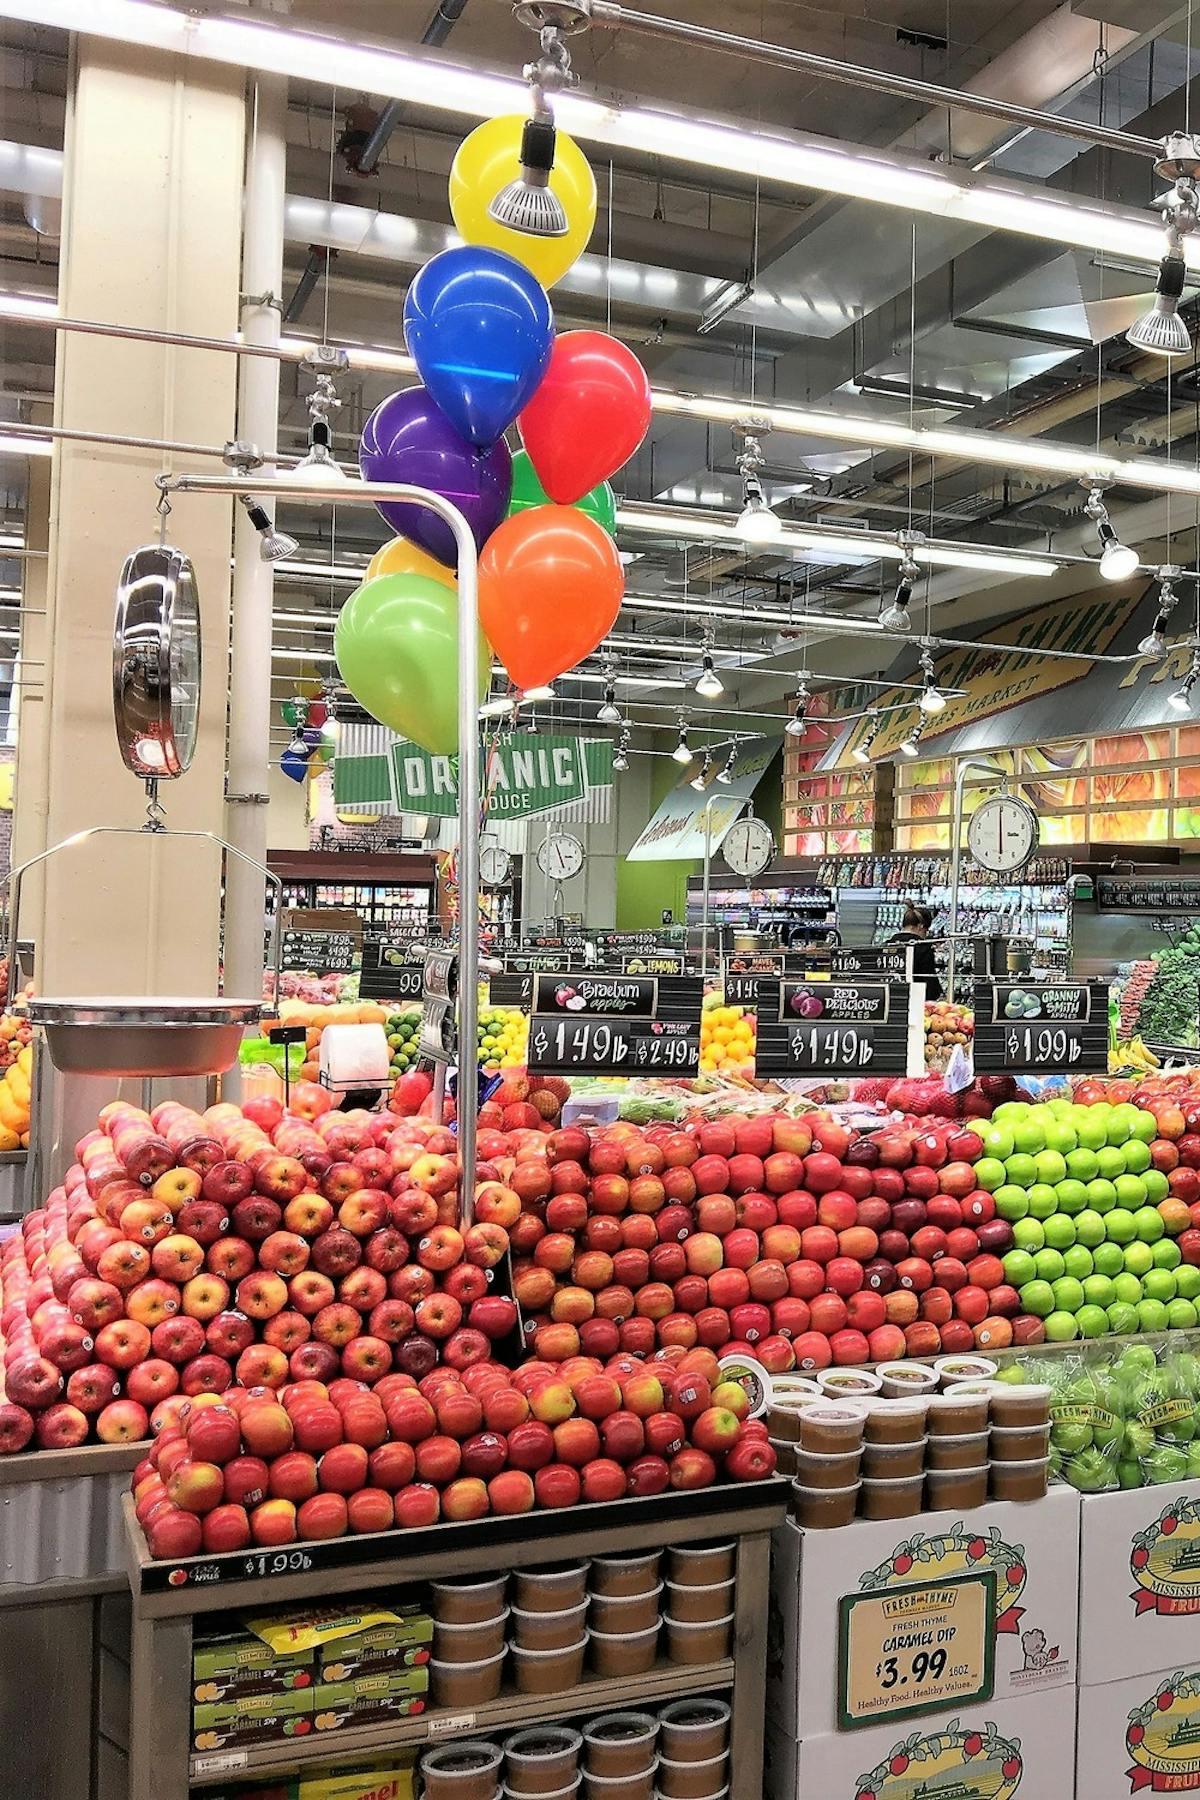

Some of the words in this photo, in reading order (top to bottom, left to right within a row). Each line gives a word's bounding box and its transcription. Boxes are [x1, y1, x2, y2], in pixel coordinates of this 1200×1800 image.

[961, 673, 1040, 717] MARKET
[403, 748, 575, 798] ORANIC
[647, 960, 679, 974] LEMONS
[578, 980, 640, 998] Braeburn
[832, 987, 859, 999] RED
[1042, 989, 1080, 1003] GRANNY
[825, 998, 880, 1012] DELICIOUS
[831, 1011, 871, 1019] APPLES
[886, 1595, 918, 1614] FRESH
[924, 1591, 955, 1604] THYME
[892, 1620, 919, 1632] FRESH
[921, 1614, 948, 1627] THYME
[883, 1631, 933, 1652] CARAMEL
[937, 1626, 956, 1643] DIP
[876, 1648, 948, 1689] $3.99
[858, 1696, 890, 1710] Healthy
[891, 1692, 911, 1703] Food.
[913, 1686, 944, 1699] Healthy
[945, 1681, 973, 1691] Values.
